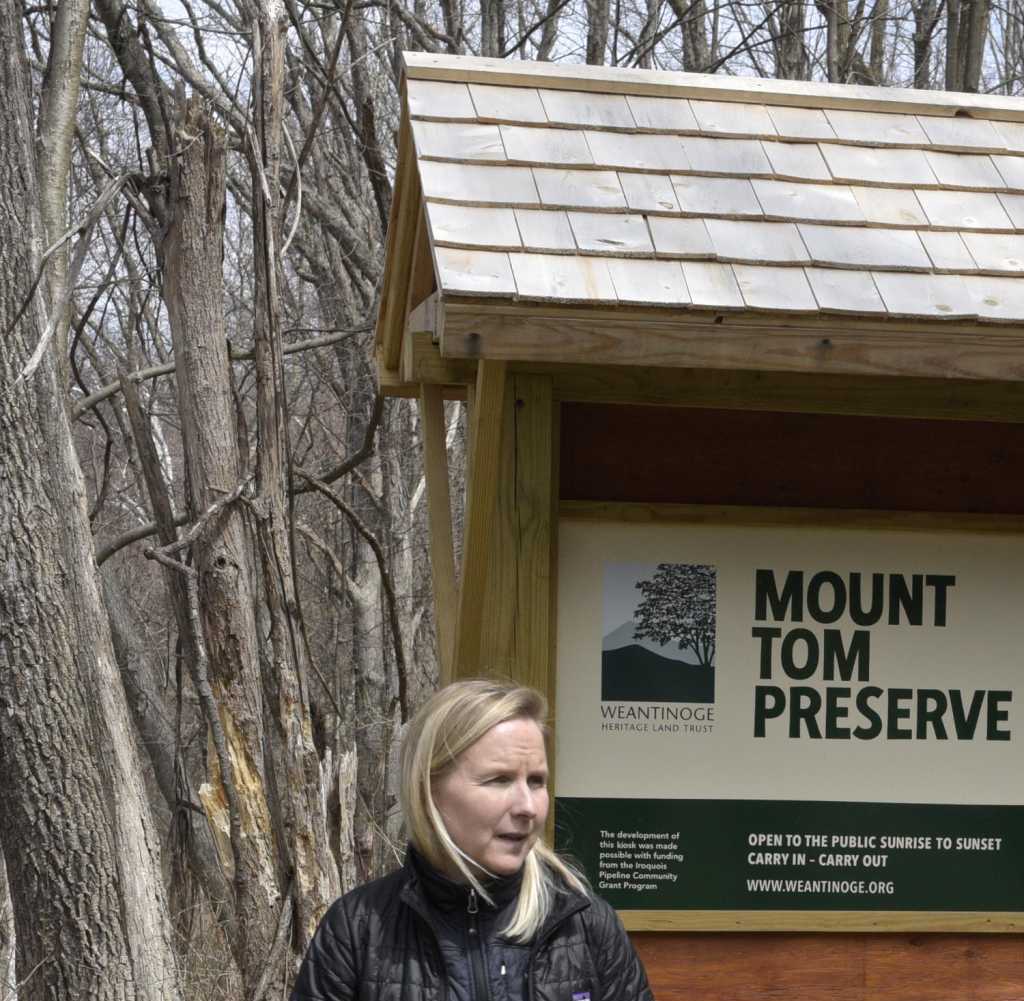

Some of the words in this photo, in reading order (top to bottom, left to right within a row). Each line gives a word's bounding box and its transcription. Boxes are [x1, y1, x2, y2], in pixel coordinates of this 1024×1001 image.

[755, 569, 956, 627] MOUNT
[752, 627, 871, 682] TOM
[600, 705, 714, 721] WEANTINOGE
[753, 685, 1013, 741] PRESERVE
[601, 723, 648, 732] HERITAGE
[652, 724, 680, 732] LAND
[684, 725, 713, 733] TRUST
[600, 830, 615, 838] The
[617, 830, 669, 840] development
[748, 833, 783, 847] OPEN
[785, 834, 801, 847] TO
[804, 835, 828, 847] THE
[831, 835, 876, 848] PUBLIC
[880, 836, 932, 849] SUNRISE
[935, 837, 952, 849] TO
[956, 837, 1002, 850] SUNSET
[616, 841, 636, 849] kiosk
[656, 842, 678, 850] made
[600, 851, 632, 859] possible
[634, 851, 651, 859] with
[653, 852, 684, 862] funding
[747, 852, 789, 865] CARRY
[792, 853, 806, 865] IN
[818, 854, 859, 867] CARRY
[862, 855, 888, 867] OUT
[635, 862, 667, 870] Iroquois
[600, 871, 630, 880] Pipeline
[633, 872, 678, 882] Community
[599, 881, 621, 889] Grant
[623, 882, 658, 891] Program
[746, 879, 895, 894] WWW.WEANTINOGE.ORG
